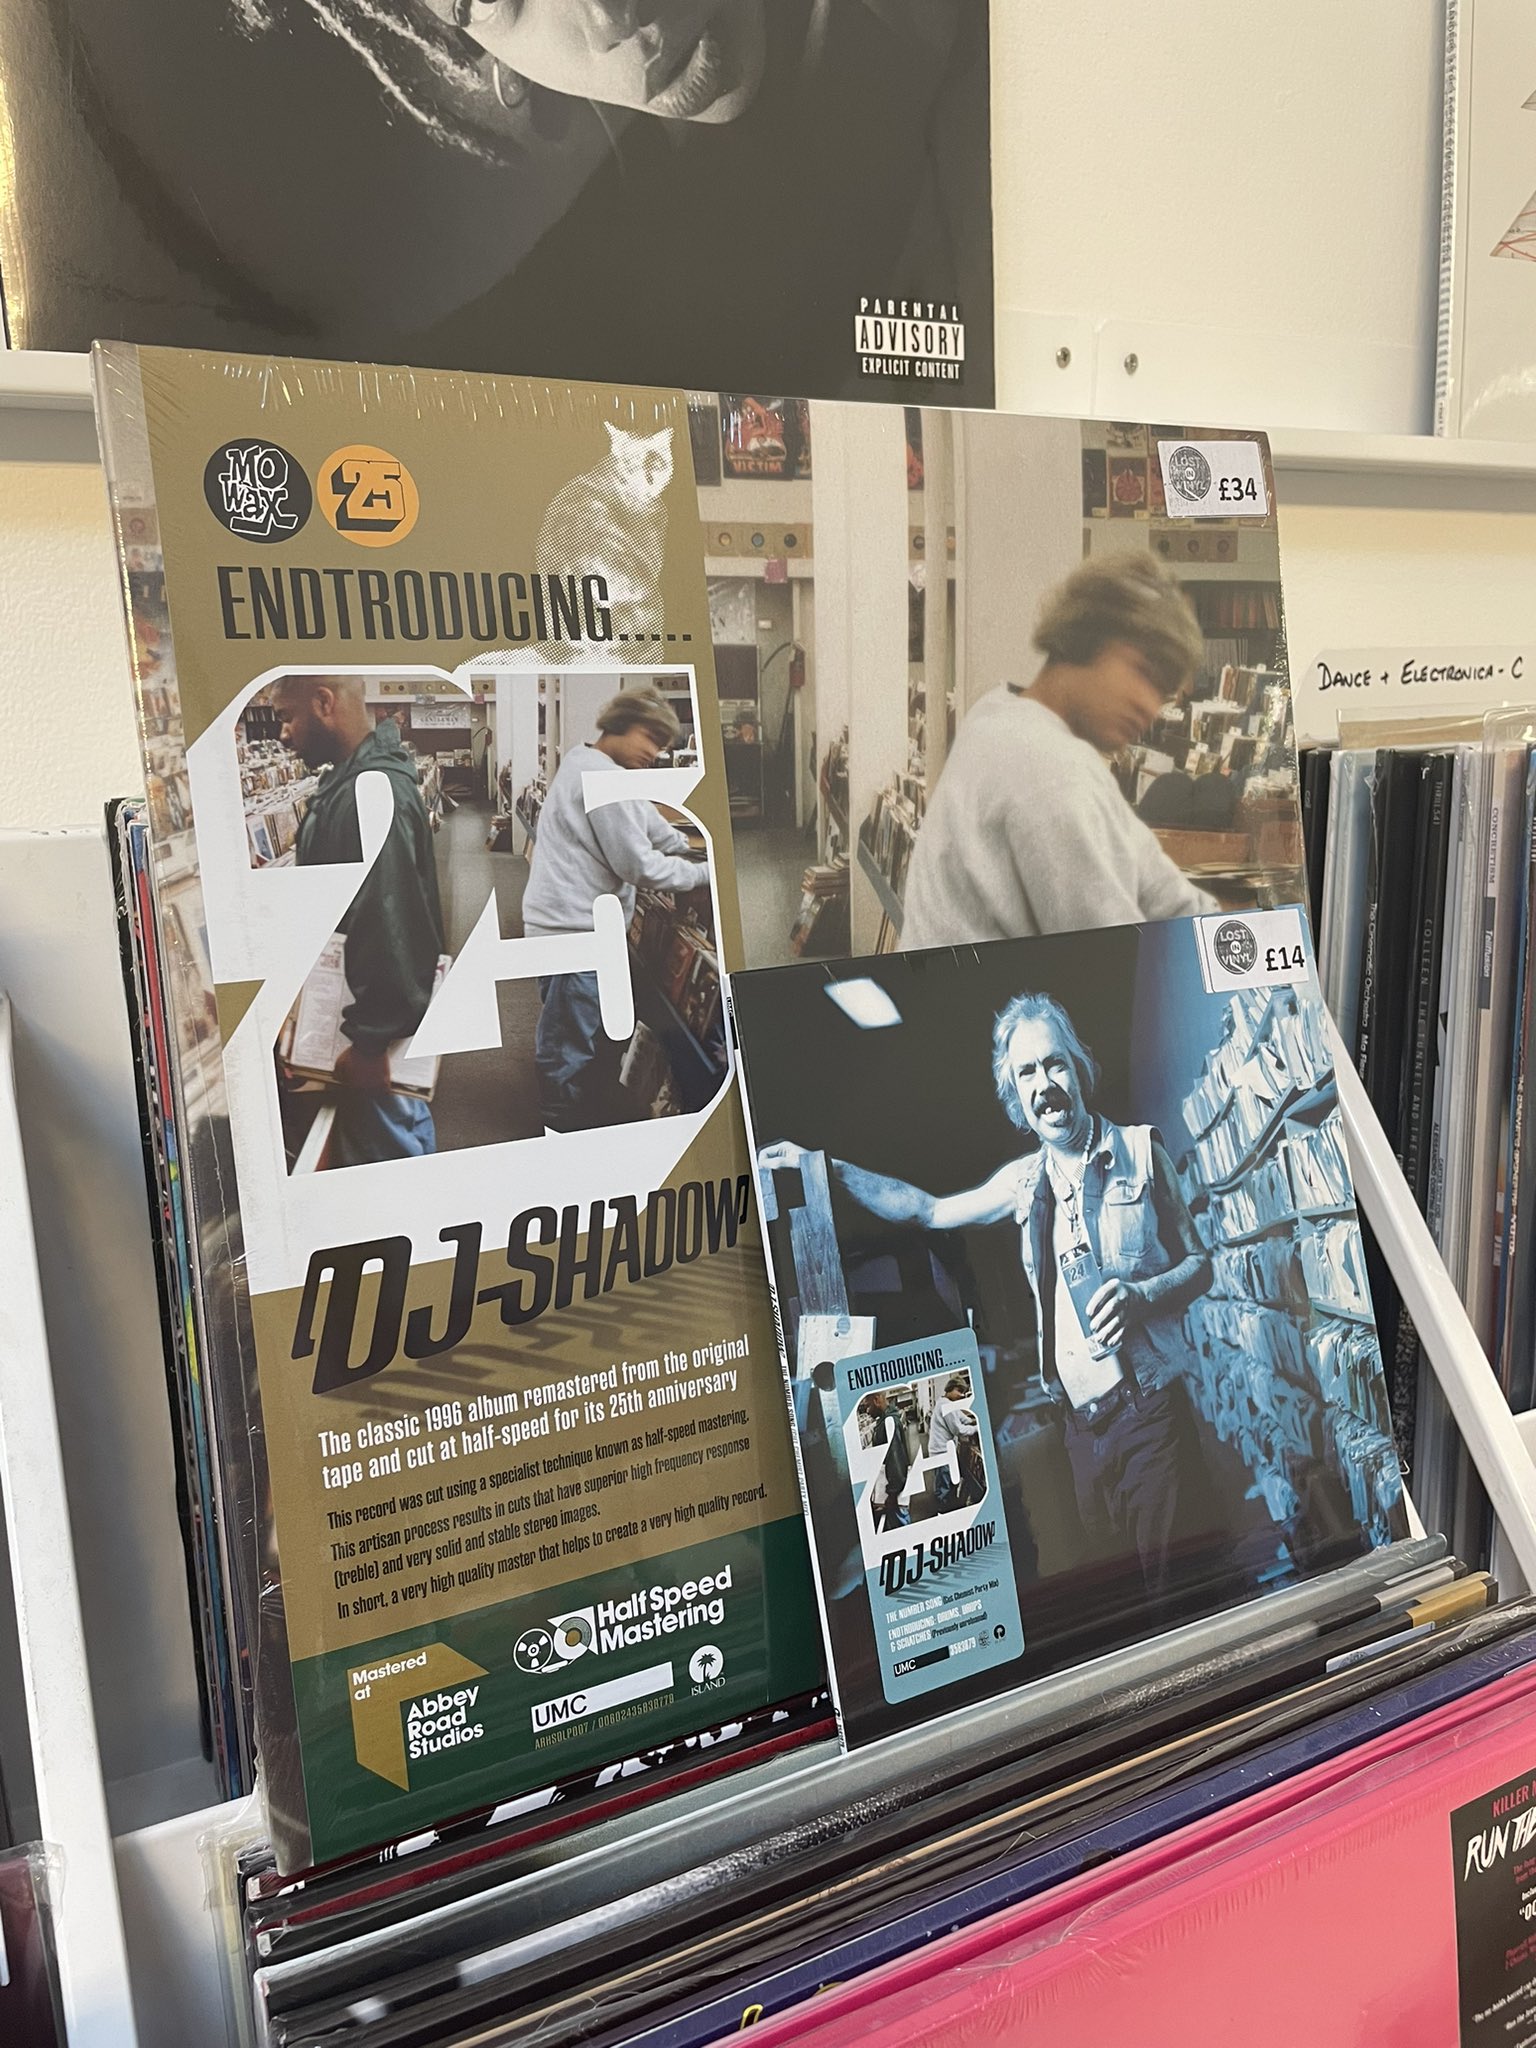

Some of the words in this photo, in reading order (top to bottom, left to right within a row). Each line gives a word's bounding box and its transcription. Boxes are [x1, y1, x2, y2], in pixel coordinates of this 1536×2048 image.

[861, 297, 959, 321] PARENTAL
[860, 319, 960, 356] ADVISORY
[862, 357, 910, 375] EXPLICIT
[915, 361, 960, 379] CONTENT
[732, 459, 784, 474] VICTIM
[1174, 454, 1201, 468] LOST
[330, 459, 406, 533] 25
[1218, 477, 1258, 501] £34
[1511, 656, 1523, 679] C
[1488, 806, 1499, 884] CONCRETISM
[1368, 902, 1378, 921] The
[1219, 929, 1248, 942] LOST
[1365, 922, 1377, 976] Cinematic
[1420, 918, 1433, 986] COLLEEN
[1221, 953, 1253, 966] VINYL
[1265, 945, 1305, 972] £14
[1361, 978, 1373, 1028] Orchestra
[1417, 1000, 1428, 1025] THE
[1413, 1032, 1426, 1087] TUNNEL
[1411, 1094, 1423, 1120] AND
[1408, 1126, 1420, 1150] THE
[318, 1431, 352, 1459] The
[357, 1413, 420, 1449] classic
[424, 1401, 463, 1433] 1996
[467, 1392, 519, 1423] album
[523, 1364, 618, 1410] remastered
[622, 1358, 660, 1386] from
[664, 1350, 688, 1376] the
[692, 1333, 751, 1370] original
[322, 1461, 363, 1490] tape
[369, 1447, 402, 1479] and
[406, 1441, 436, 1470] cut
[440, 1435, 458, 1462] at
[461, 1411, 550, 1456] half-speed
[553, 1407, 579, 1432] for
[584, 1401, 606, 1425] its
[609, 1389, 644, 1419] 25th
[647, 1369, 738, 1410] anniversary
[327, 1511, 353, 1530] This
[355, 1497, 397, 1523] record
[399, 1493, 424, 1512] was
[426, 1486, 445, 1504] cut
[446, 1480, 477, 1500] using
[479, 1476, 487, 1491] a
[489, 1461, 540, 1491] specialist
[542, 1448, 593, 1475] technique
[595, 1439, 629, 1461] known
[631, 1436, 643, 1450] as
[645, 1419, 696, 1448] half-speed
[698, 1407, 750, 1434] mastering.
[330, 1542, 356, 1561] This
[358, 1530, 401, 1555] artisan
[404, 1517, 450, 1544] process
[452, 1505, 492, 1530] results
[495, 1501, 505, 1518] in
[508, 1495, 531, 1515] cuts
[533, 1487, 555, 1508] that
[557, 1482, 582, 1501] have
[584, 1468, 629, 1494] superior
[631, 1461, 653, 1481] high
[654, 1449, 703, 1476] frequency
[706, 1437, 750, 1461] response
[334, 1561, 380, 1590] (treble)
[382, 1553, 404, 1575] and
[406, 1548, 432, 1569] very
[435, 1538, 462, 1560] solid
[465, 1531, 485, 1552] and
[488, 1522, 521, 1545] stable
[523, 1514, 558, 1536] stereo
[560, 1501, 601, 1526] images.
[337, 1602, 350, 1619] In
[391, 1590, 399, 1604] a
[401, 1581, 428, 1602] very
[430, 1572, 455, 1594] high
[458, 1561, 495, 1587] quality
[498, 1551, 537, 1574] master
[539, 1542, 561, 1562] that
[562, 1530, 591, 1556] helps
[593, 1529, 603, 1546] to
[605, 1521, 639, 1543] create
[641, 1519, 647, 1532] a
[649, 1511, 672, 1530] very
[674, 1503, 696, 1523] high
[698, 1495, 730, 1517] quality
[732, 1483, 768, 1507] record.
[597, 1590, 647, 1627] Half
[649, 1564, 733, 1613] Speed
[885, 1612, 898, 1624] THE
[898, 1601, 925, 1619] NUMBER
[925, 1595, 943, 1610] SONG
[600, 1598, 725, 1654] Mastering
[890, 1641, 896, 1653] &
[896, 1629, 932, 1651] SCRATCHES
[352, 1652, 427, 1686] Mastered
[894, 1659, 917, 1676] UMC
[354, 1685, 372, 1701] at
[691, 1677, 726, 1696] ISLAND
[407, 1685, 480, 1723] Abbey
[534, 1694, 588, 1727] UMC
[407, 1706, 467, 1742] Road
[409, 1722, 485, 1760] Studios
[1492, 1785, 1530, 1818] KILLER
[1463, 1819, 1511, 1882] RUN
